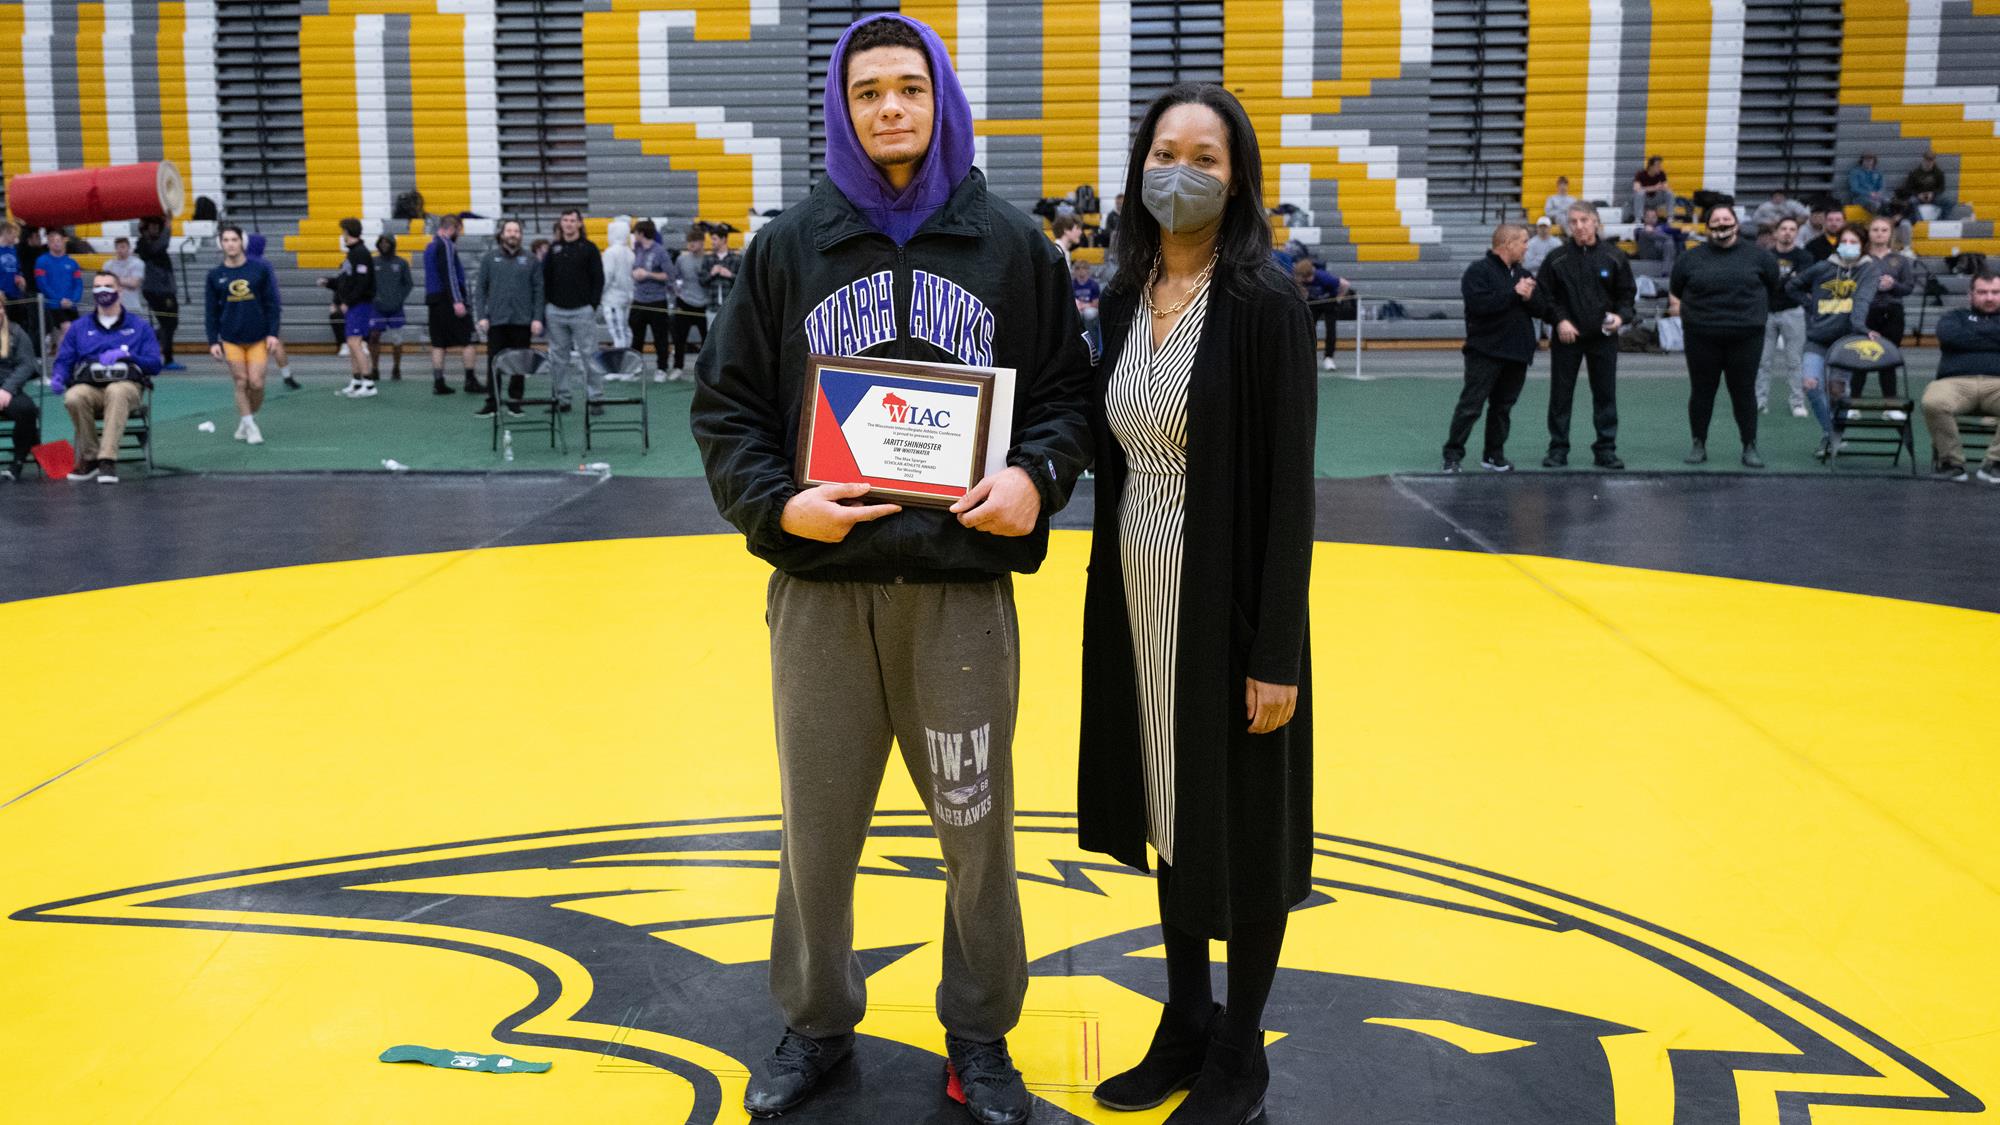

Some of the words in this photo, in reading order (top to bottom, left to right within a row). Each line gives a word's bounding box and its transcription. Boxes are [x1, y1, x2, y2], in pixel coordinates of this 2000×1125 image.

[883, 403, 951, 428] WIAC
[883, 438, 904, 446] JARITT
[904, 440, 942, 451] SHINHOSTER
